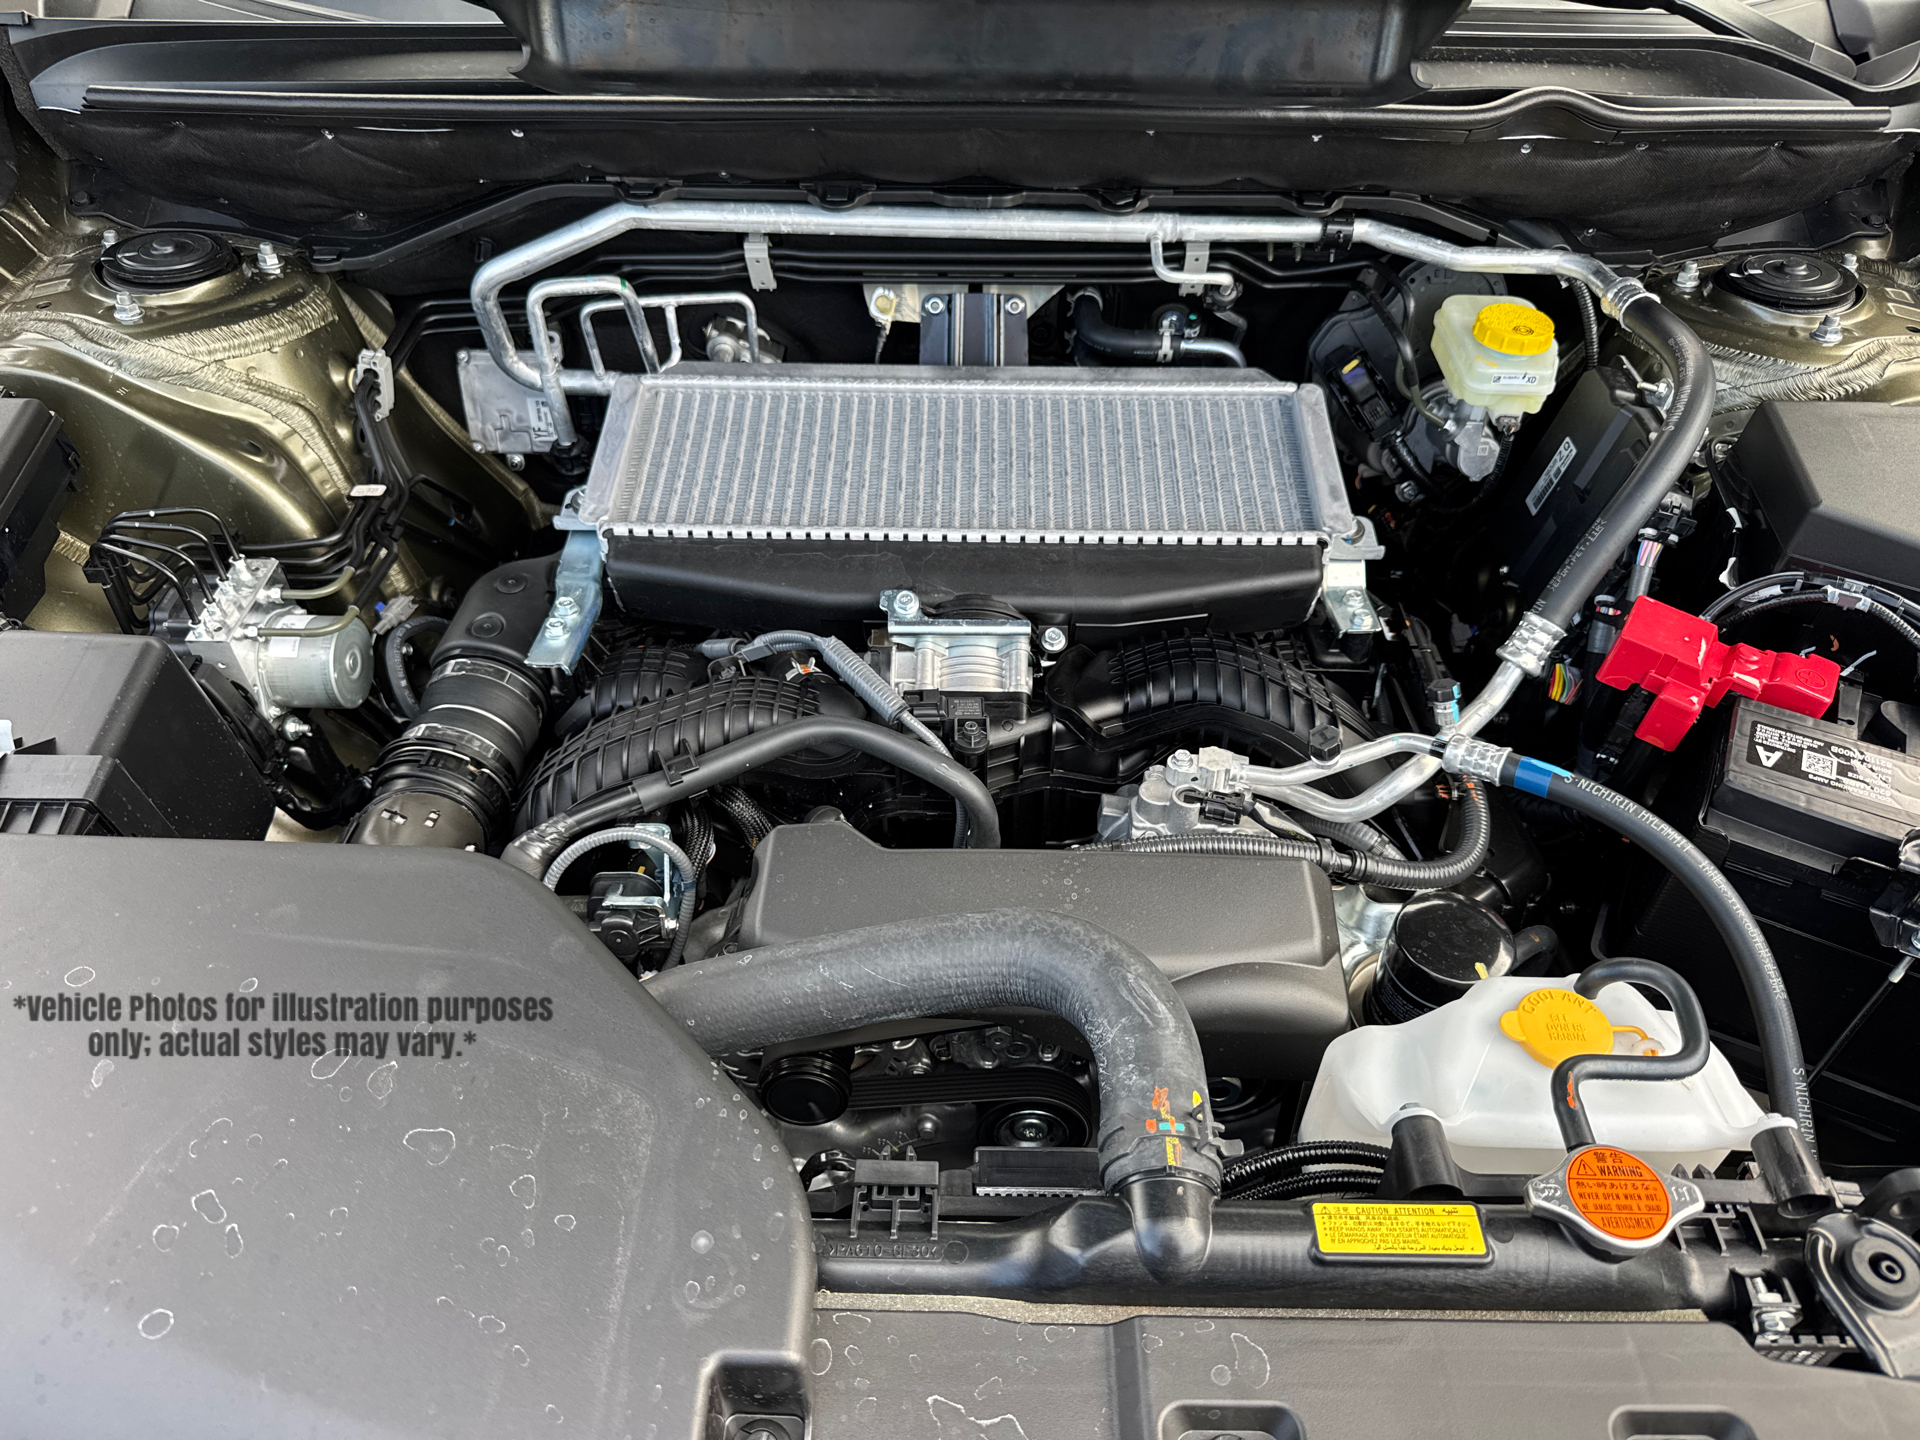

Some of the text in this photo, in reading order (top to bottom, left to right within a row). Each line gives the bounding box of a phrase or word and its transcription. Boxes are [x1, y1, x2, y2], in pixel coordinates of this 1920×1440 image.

[1755, 745, 1784, 768] A
[1808, 774, 1831, 784] AMPS
[1637, 810, 1695, 853] HYLAMMIT
[1522, 990, 1597, 1014] COOLANT
[1550, 1014, 1570, 1023] SEE
[1549, 1033, 1587, 1042] MANUAL
[1594, 1151, 1623, 1164] 警告
[1597, 1165, 1643, 1177] WARNING
[1578, 1192, 1599, 1200] NEVER
[1602, 1192, 1620, 1201] OPEN
[1622, 1193, 1642, 1201] WHEN
[1355, 1207, 1435, 1216] CAUTION ATTENTION
